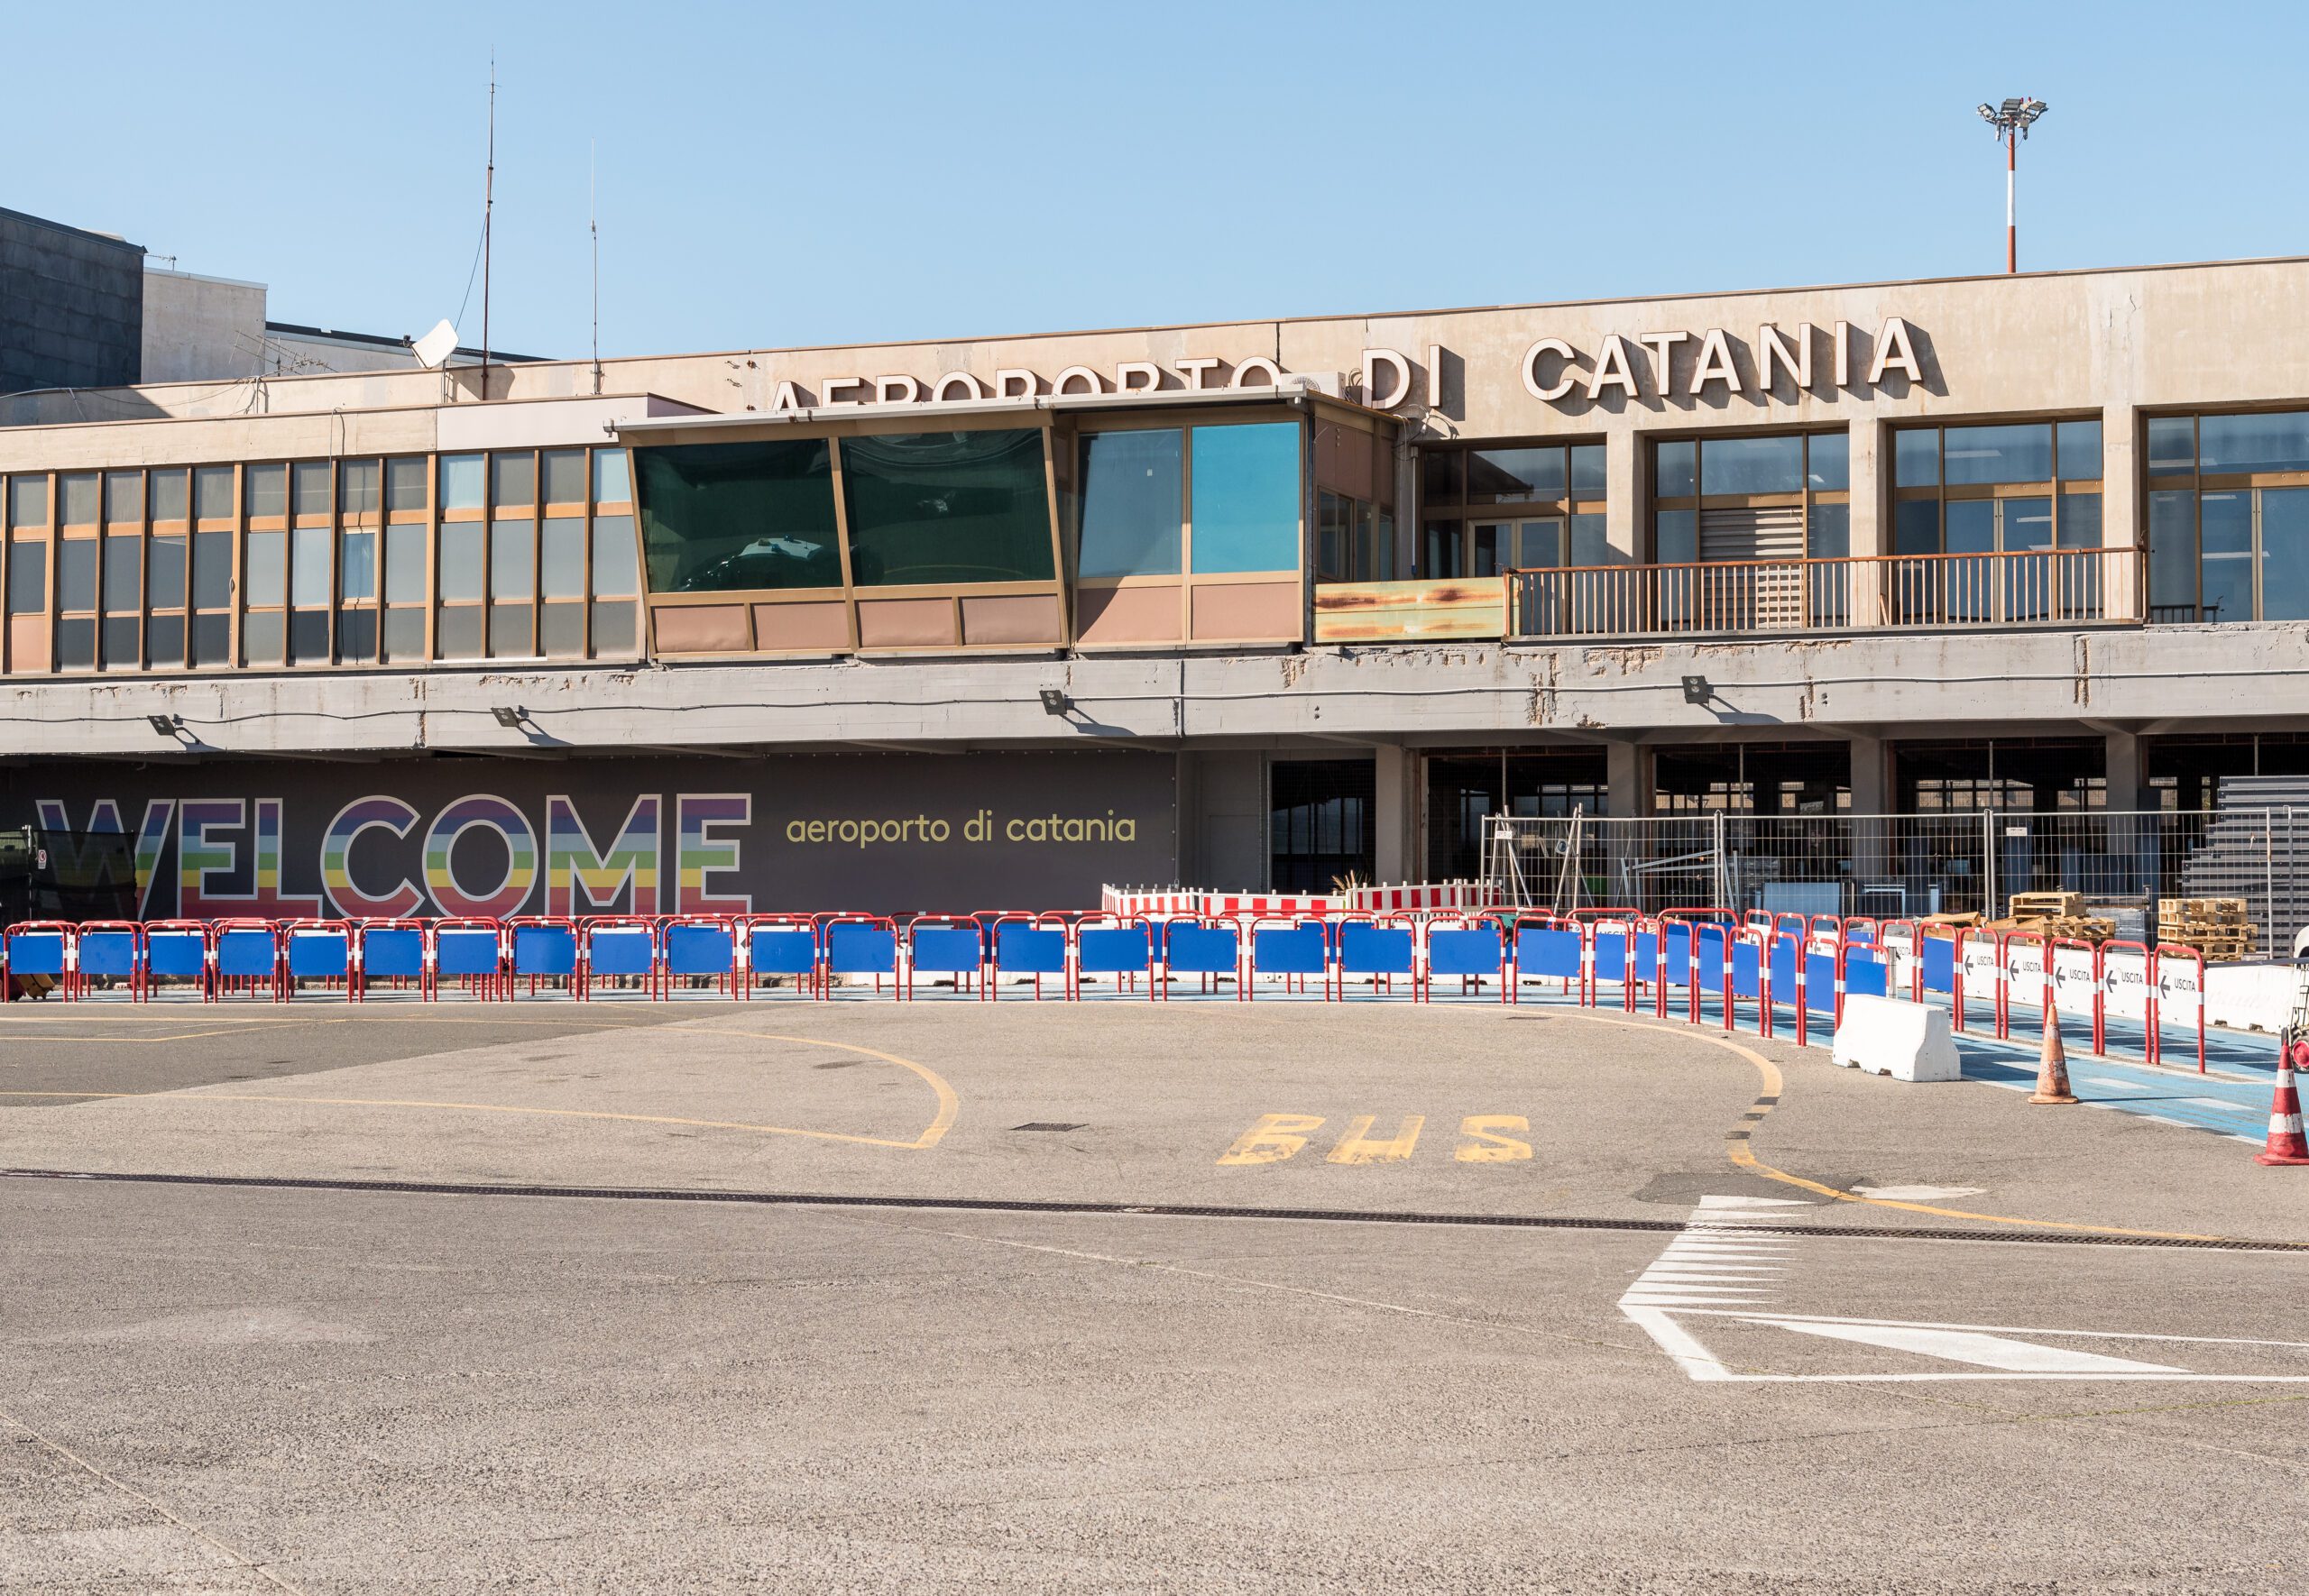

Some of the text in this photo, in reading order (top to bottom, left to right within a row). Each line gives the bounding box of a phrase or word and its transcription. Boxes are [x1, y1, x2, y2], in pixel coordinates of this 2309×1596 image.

[1360, 344, 1441, 411] DI
[1522, 317, 1923, 401] CATANIA
[786, 809, 1136, 848] aeroporto di catania
[36, 793, 752, 920] WELCOME
[1897, 946, 1911, 956] SCITA
[1976, 956, 1994, 967] USCITA
[2022, 961, 2041, 973] USCITA
[2069, 968, 2091, 982] USCITA
[2121, 972, 2144, 985] USCITA
[2174, 977, 2196, 992] USCITA
[1216, 1114, 1532, 1164] BUS
